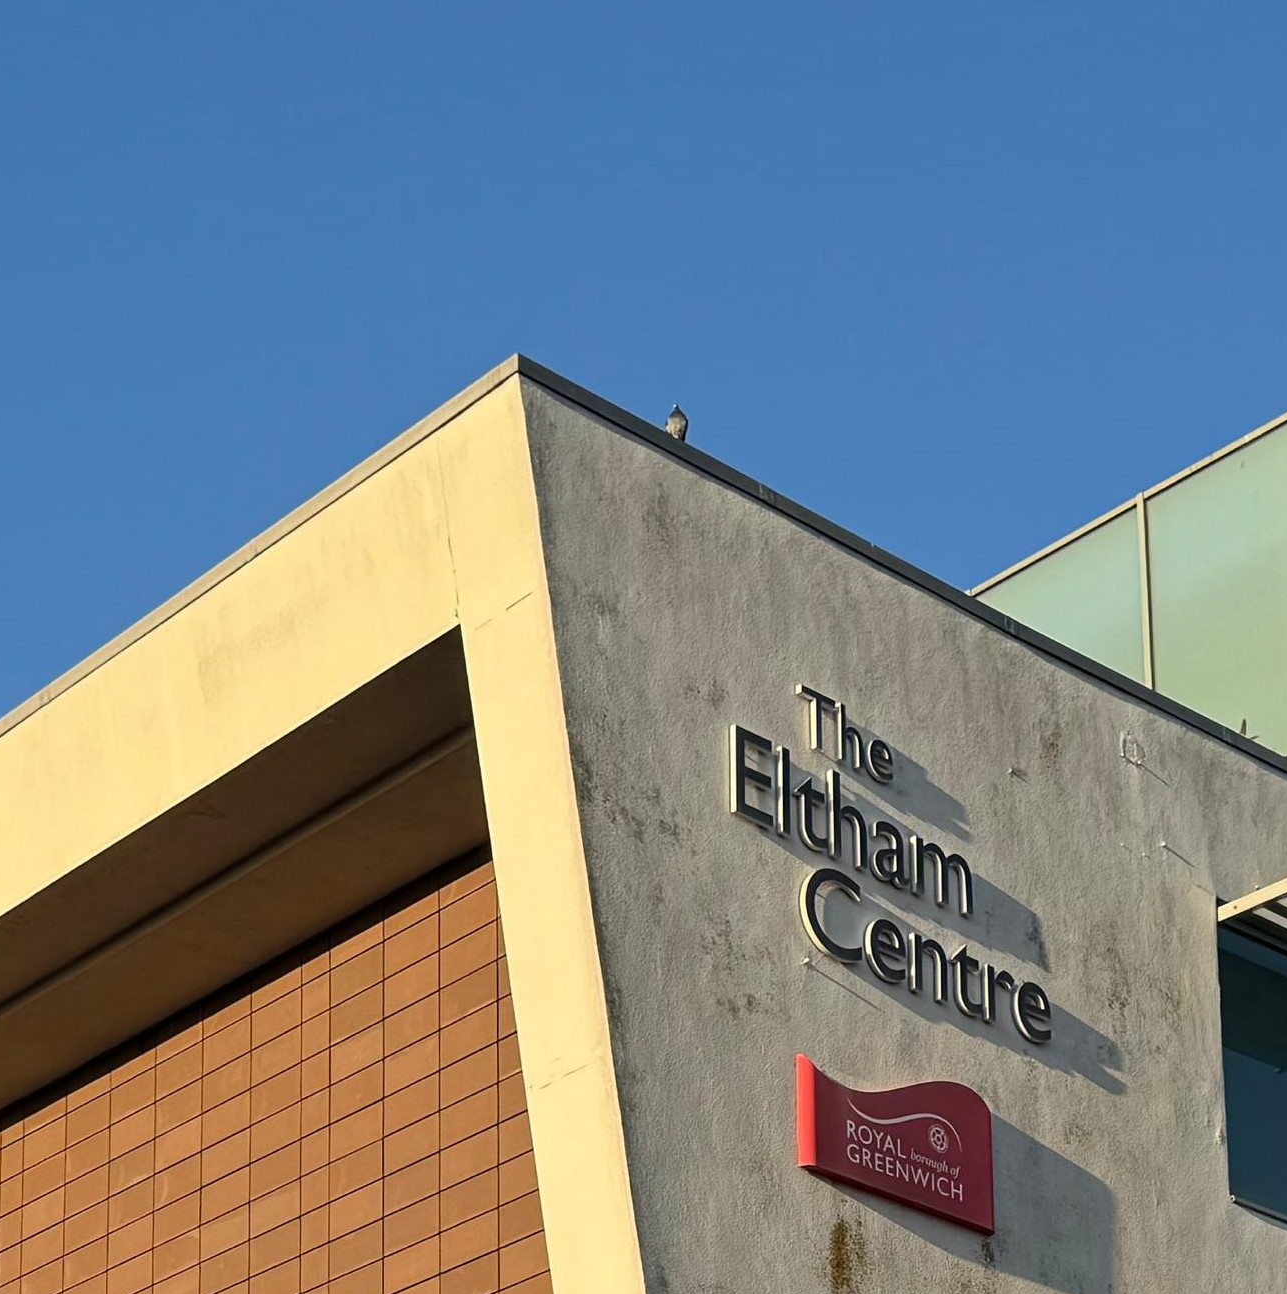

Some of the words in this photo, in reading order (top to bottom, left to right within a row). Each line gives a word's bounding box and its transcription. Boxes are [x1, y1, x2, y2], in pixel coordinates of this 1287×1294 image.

[794, 683, 893, 785] The
[729, 723, 973, 918] Eltham
[799, 868, 1052, 1044] Centre
[846, 1119, 907, 1159] ROYAL
[910, 1148, 949, 1174] borough
[949, 1165, 961, 1180] of
[846, 1143, 963, 1202] GREENWICH
